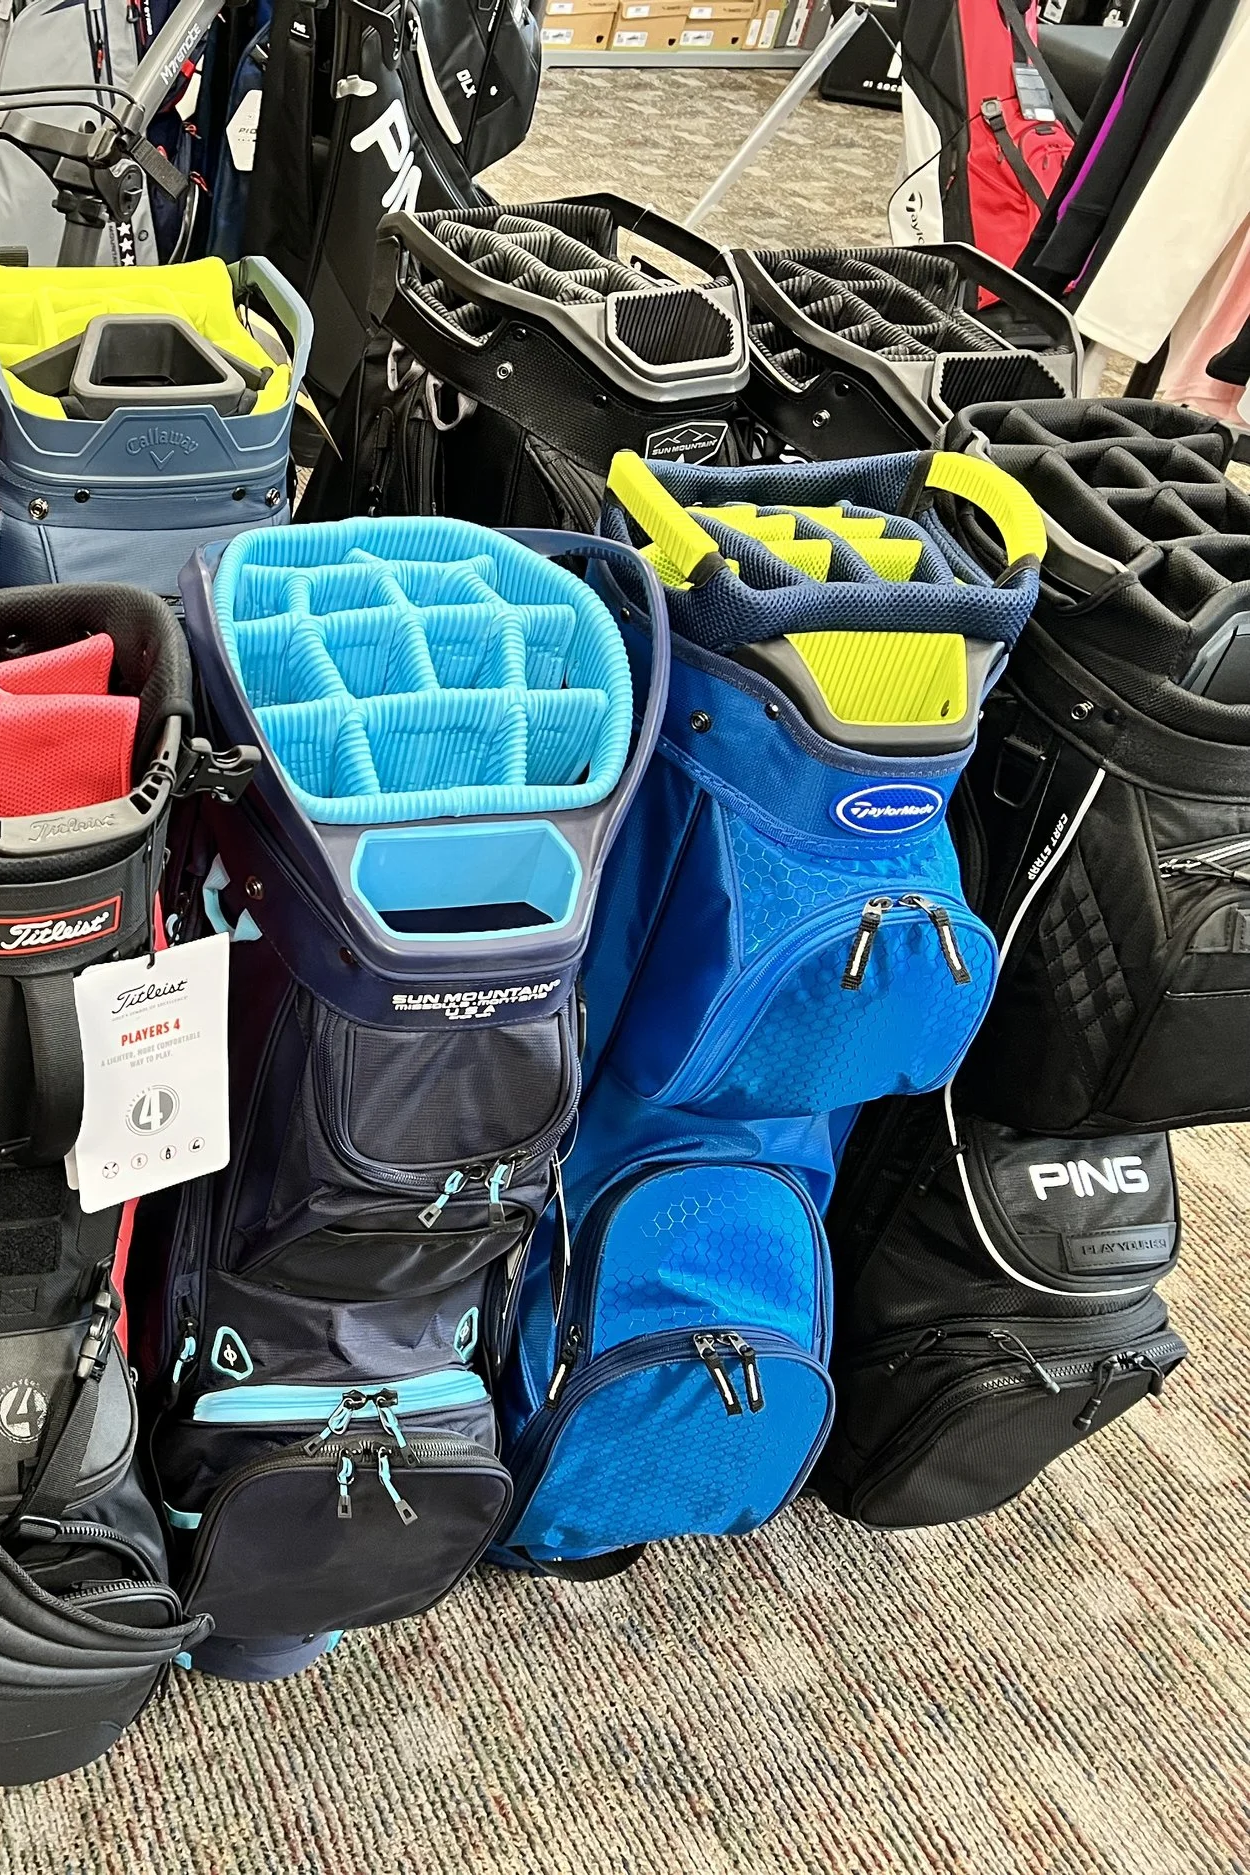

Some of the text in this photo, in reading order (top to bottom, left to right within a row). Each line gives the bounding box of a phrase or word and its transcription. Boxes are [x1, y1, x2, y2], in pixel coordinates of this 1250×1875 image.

[126, 427, 199, 456] Callaway
[651, 439, 718, 456] SUN MOUNTAIN
[851, 801, 935, 819] TaylorMade
[28, 814, 116, 842] Titleist
[1027, 813, 1068, 880] CART STRAP
[0, 911, 110, 950] Titleist
[111, 979, 188, 1014] Titleist
[392, 993, 440, 1005] SUN
[121, 1018, 181, 1047] PLAYERS 4
[137, 1045, 155, 1056] MORE
[157, 1031, 201, 1051] COMFORTABLE
[130, 1057, 144, 1068] WAY
[146, 1055, 154, 1064] TO
[1028, 1155, 1150, 1201] PING
